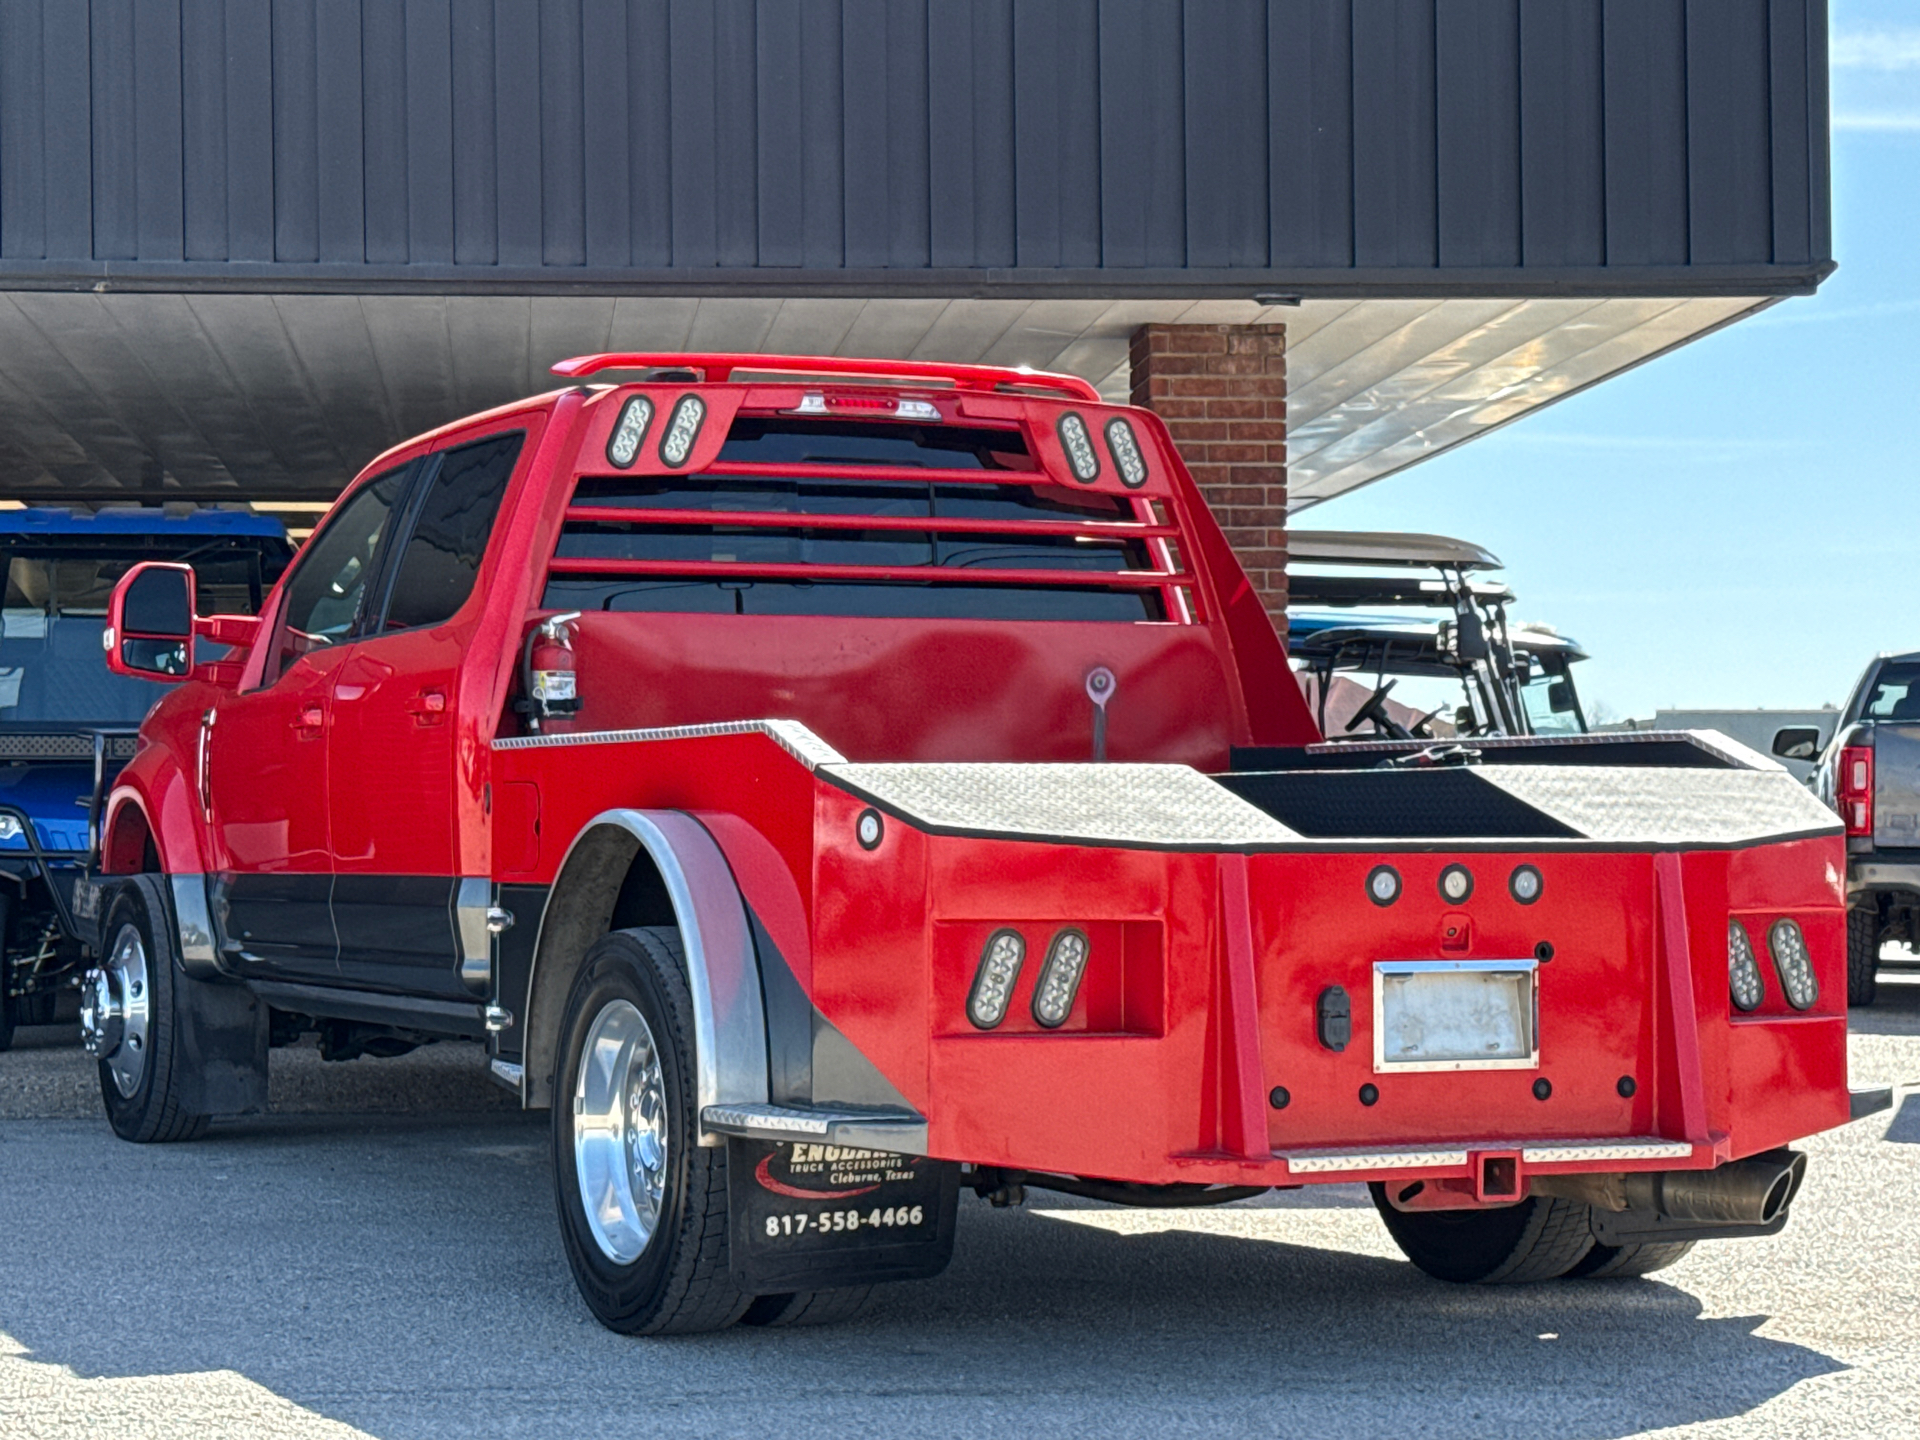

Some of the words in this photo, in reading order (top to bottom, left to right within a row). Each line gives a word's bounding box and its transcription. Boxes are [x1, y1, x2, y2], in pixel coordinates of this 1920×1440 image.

[790, 1143, 902, 1162] ENGL
[790, 1162, 824, 1174] TRUCK
[830, 1158, 903, 1171] ACCESSORIES
[830, 1171, 882, 1184] Cleburne,
[885, 1169, 915, 1181] Texas
[765, 1205, 923, 1236] 817-558-4466
